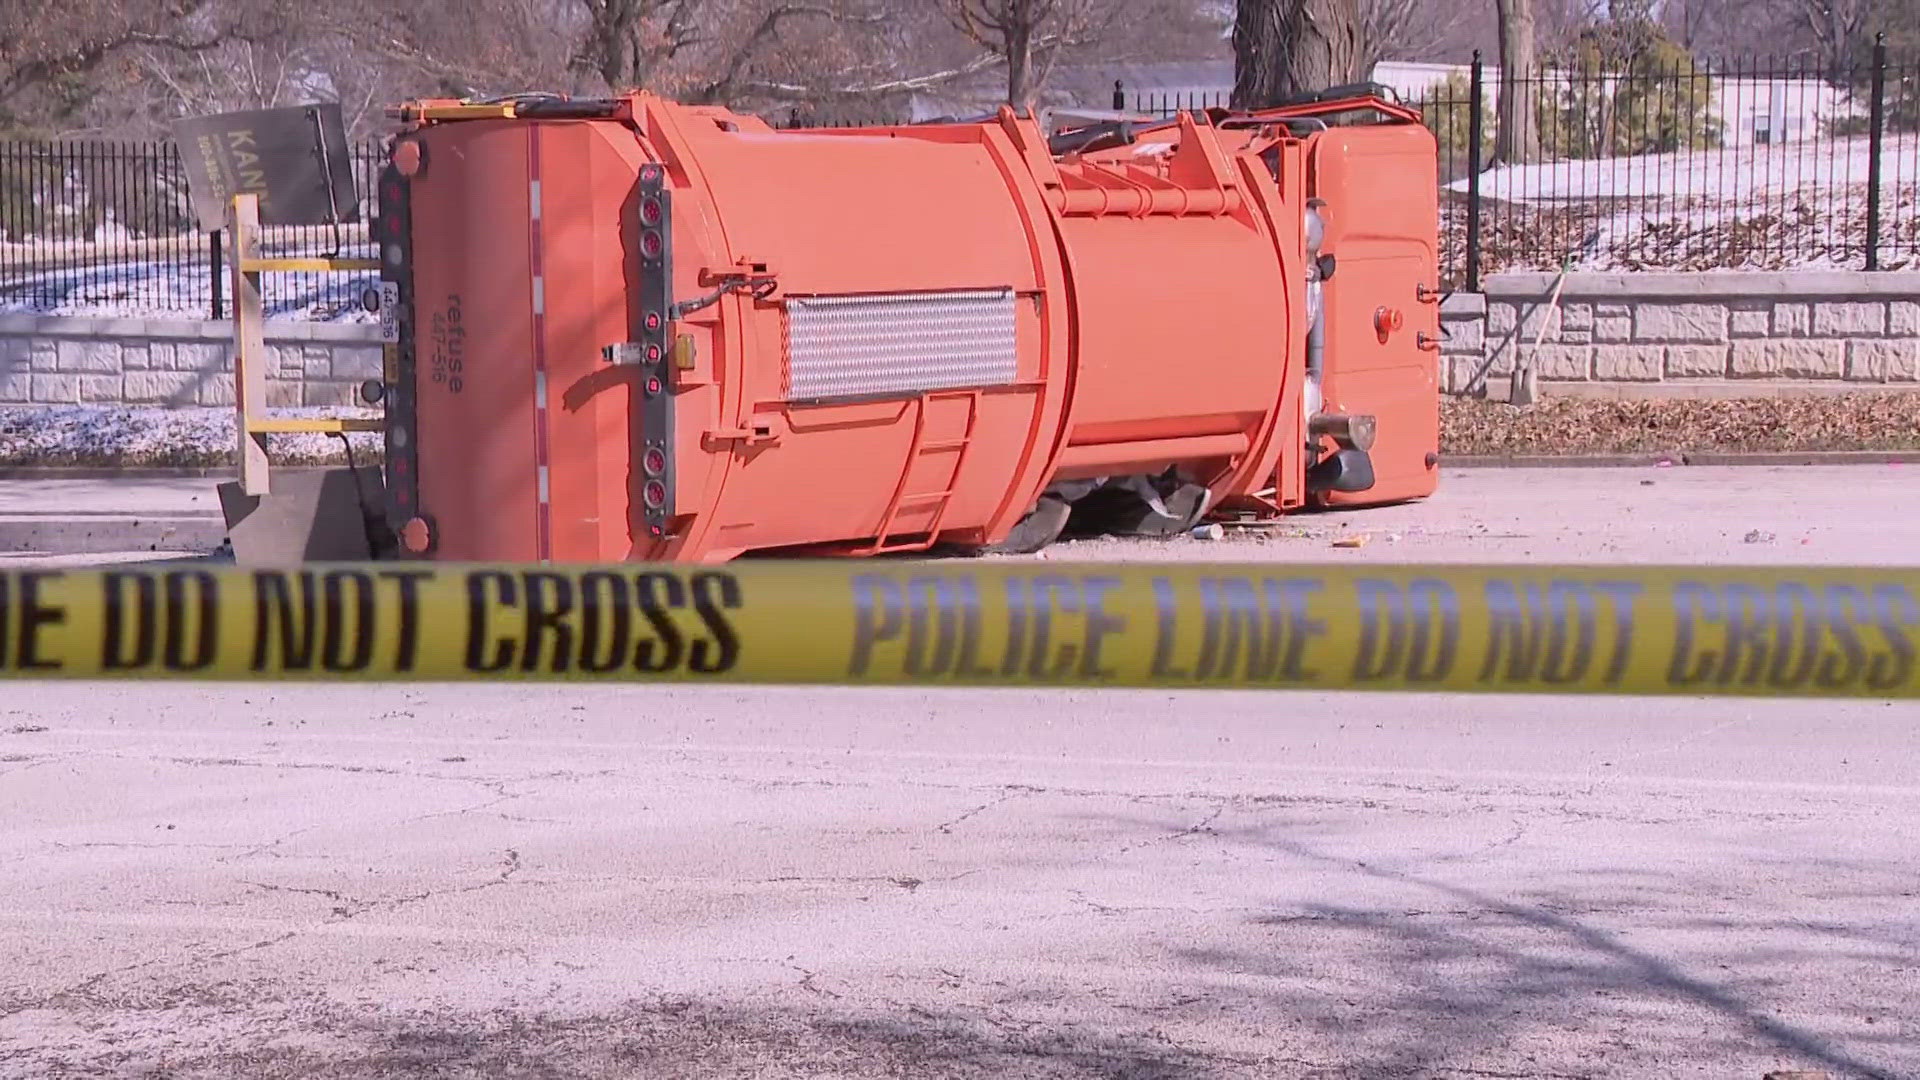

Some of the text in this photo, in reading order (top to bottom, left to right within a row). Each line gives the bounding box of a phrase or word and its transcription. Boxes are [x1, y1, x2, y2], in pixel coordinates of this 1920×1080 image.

[447, 292, 465, 394] refuse
[0, 569, 743, 675] E DO NOT CROSS
[848, 573, 1920, 691] POLICE LINE DO NOT CROSS
